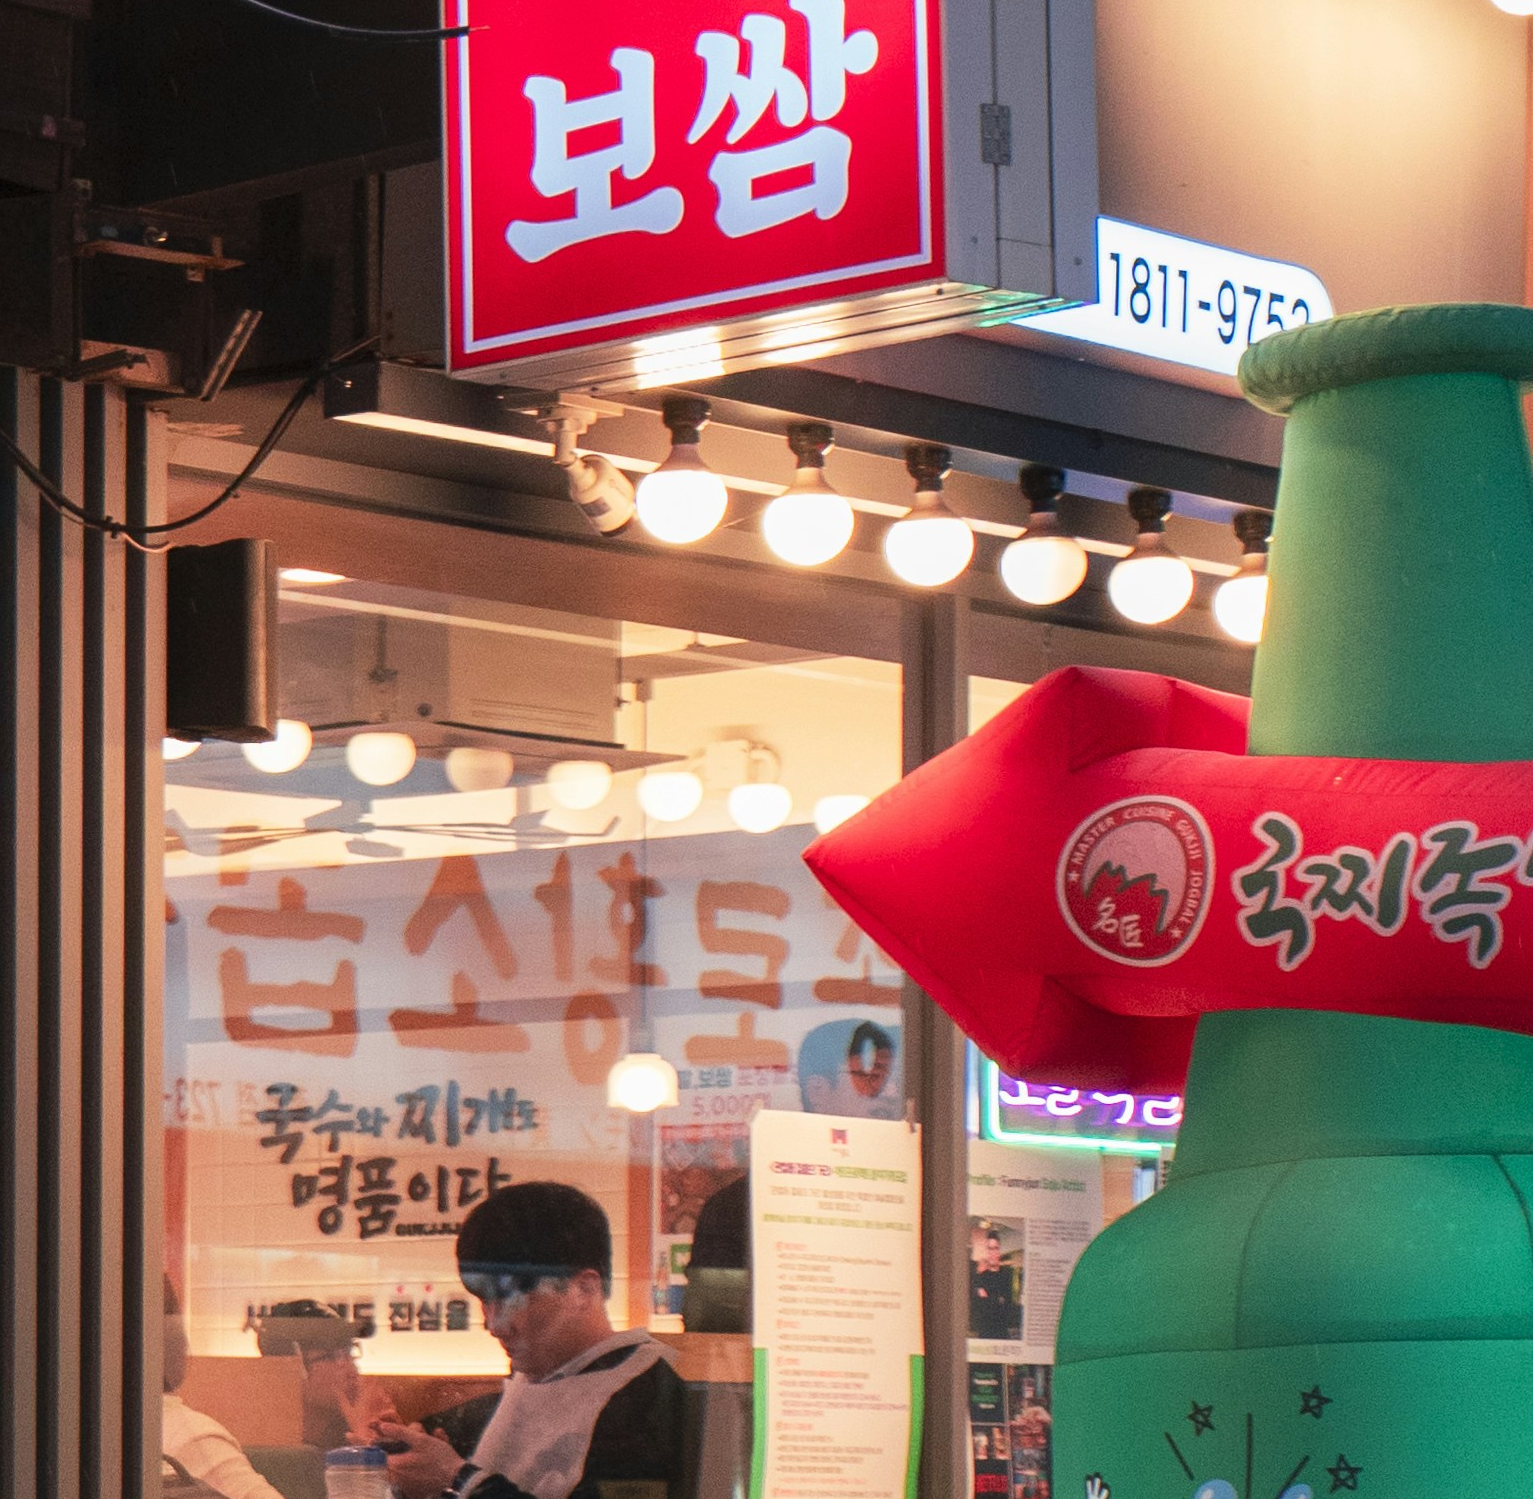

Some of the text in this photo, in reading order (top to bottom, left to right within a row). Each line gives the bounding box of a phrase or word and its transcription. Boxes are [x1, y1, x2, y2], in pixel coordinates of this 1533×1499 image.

[1071, 816, 1116, 866] MASTER
[1231, 811, 1533, 972] 국찌족
[255, 1082, 390, 1164] 국수와
[291, 1155, 513, 1239] 명품이다
